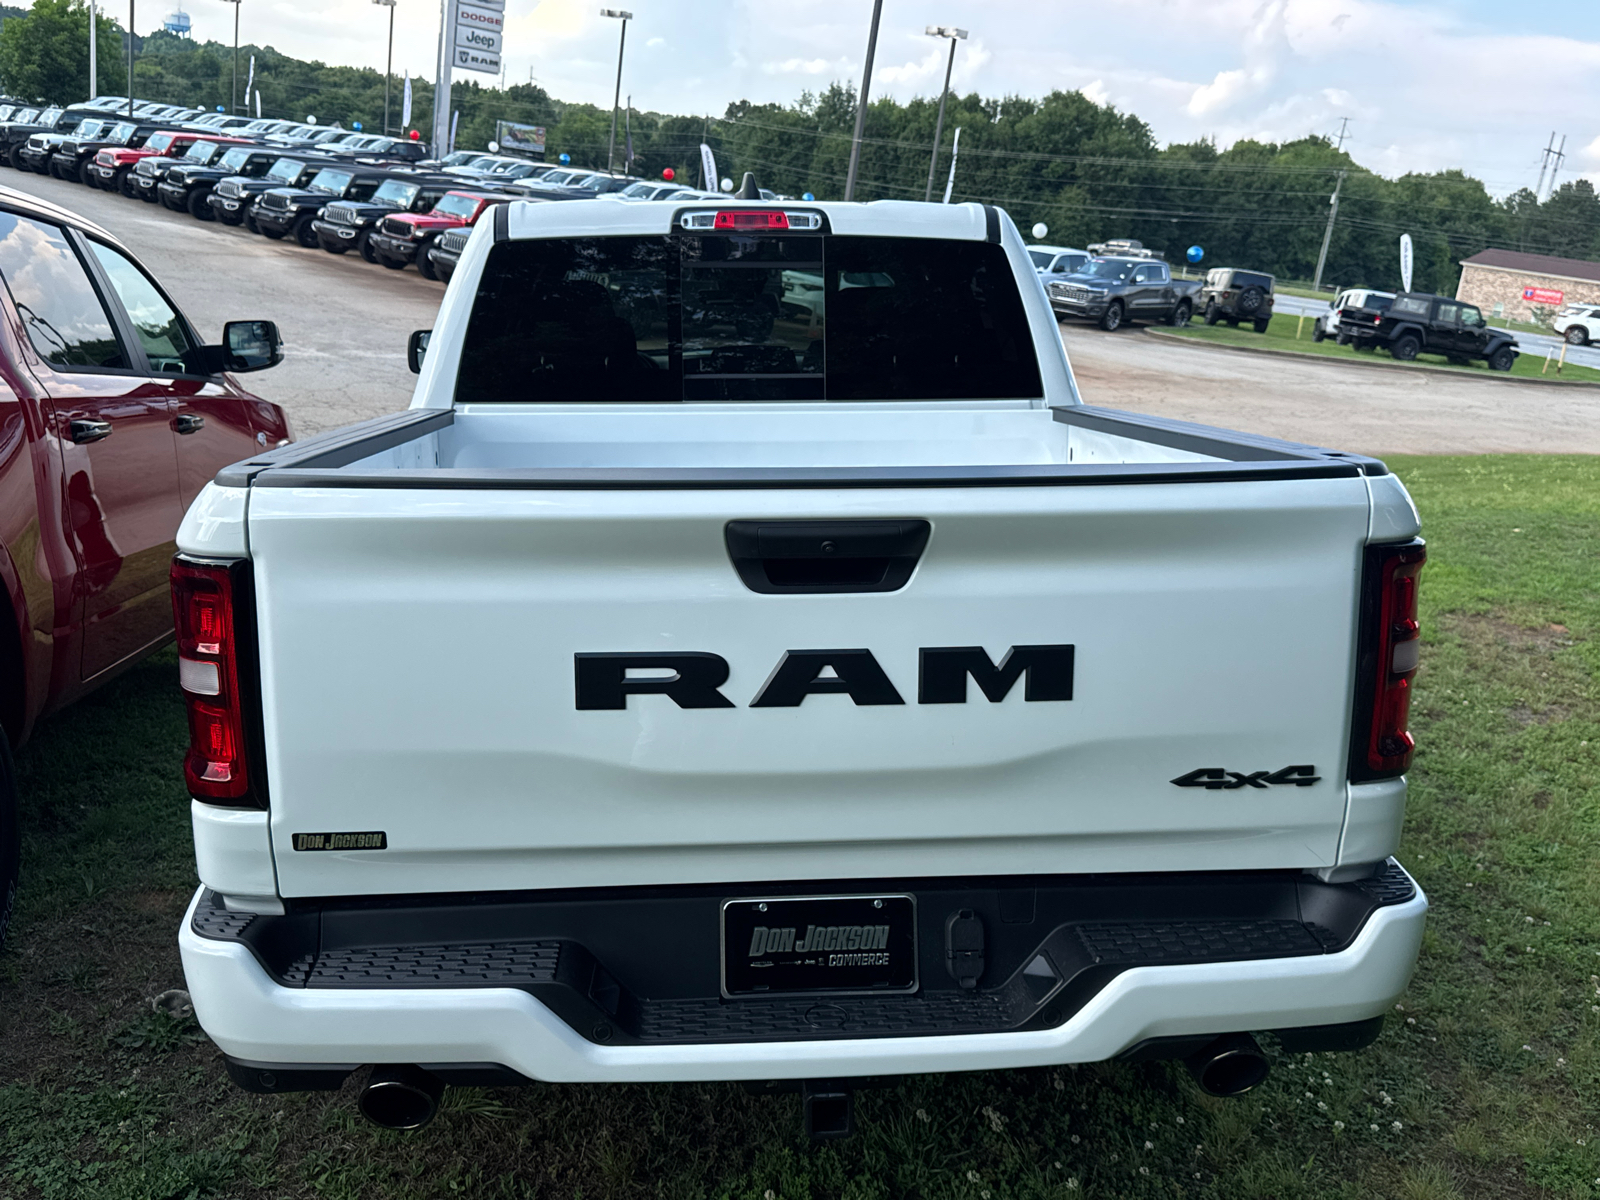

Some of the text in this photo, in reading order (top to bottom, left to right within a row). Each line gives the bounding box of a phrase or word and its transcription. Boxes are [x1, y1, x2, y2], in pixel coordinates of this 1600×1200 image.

[461, 12, 501, 25] DODGE
[466, 31, 495, 48] Jeep
[471, 56, 498, 67] RAM
[574, 644, 1075, 710] RAM
[1169, 764, 1322, 789] 4x4
[297, 833, 383, 850] DON JACKSON
[748, 924, 891, 957] DON JACKSON
[828, 953, 889, 967] COMMERCE
